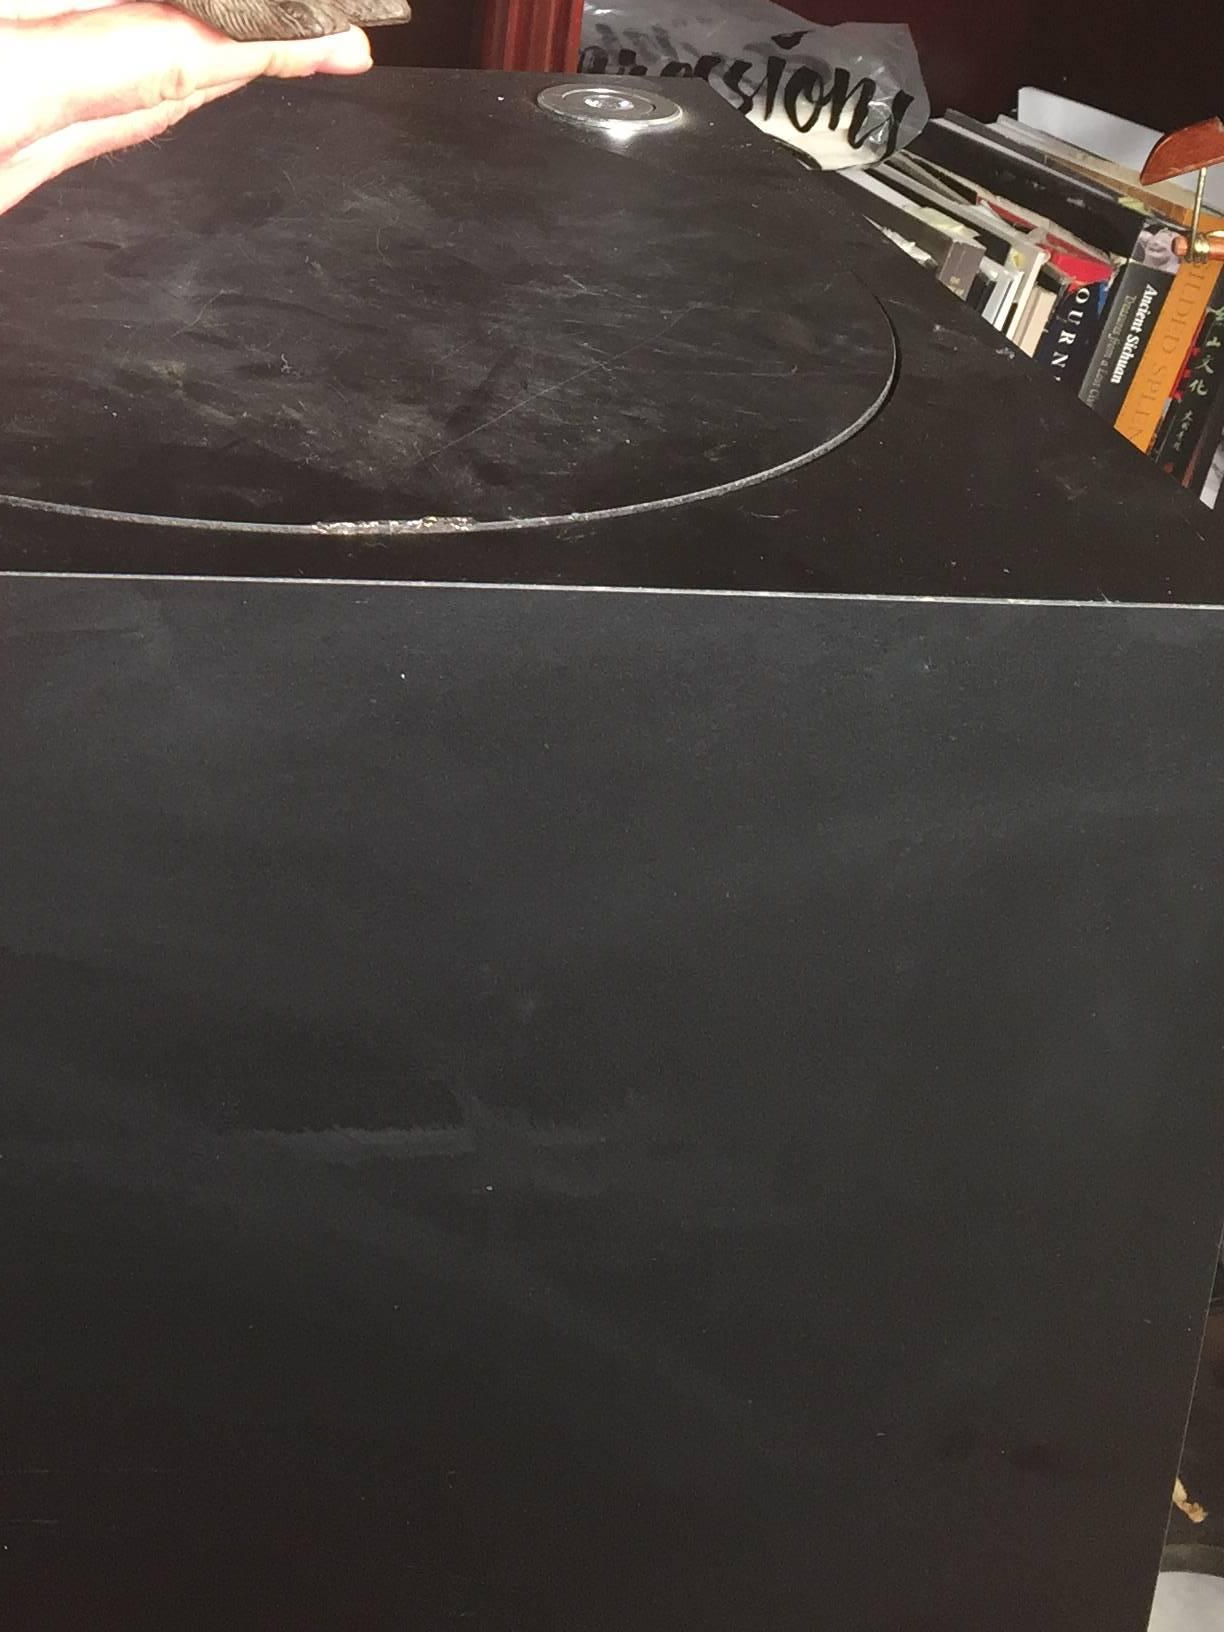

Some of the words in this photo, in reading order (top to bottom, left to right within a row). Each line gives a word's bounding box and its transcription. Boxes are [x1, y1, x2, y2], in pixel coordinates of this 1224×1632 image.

[1111, 292, 1136, 336] Treasures
[1129, 283, 1159, 335] Ancient
[1050, 288, 1090, 382] OURN
[1100, 332, 1121, 360] from
[1092, 367, 1108, 388] Lost
[1100, 359, 1108, 367] a
[1109, 332, 1141, 386] Sichuan
[1084, 387, 1100, 409] Civ
[1123, 360, 1169, 443] SPLEN
